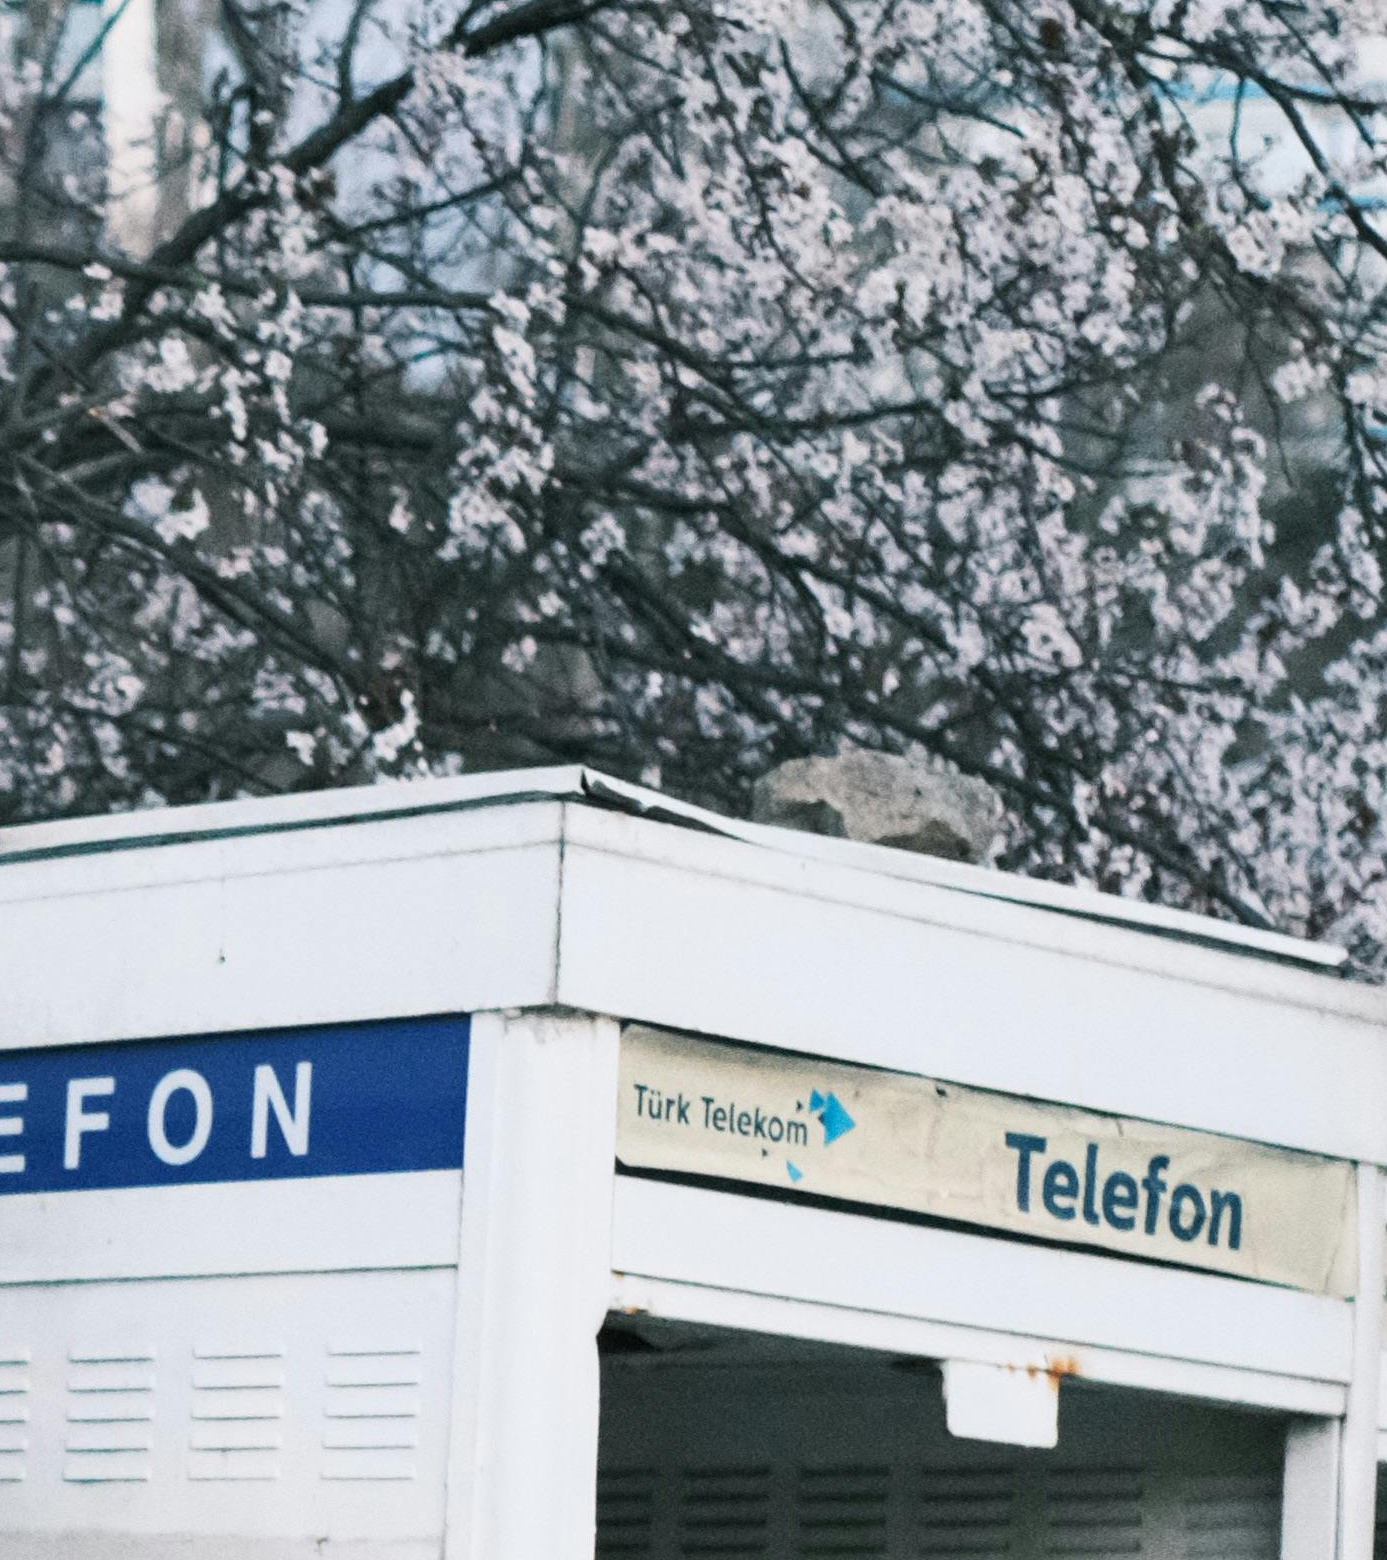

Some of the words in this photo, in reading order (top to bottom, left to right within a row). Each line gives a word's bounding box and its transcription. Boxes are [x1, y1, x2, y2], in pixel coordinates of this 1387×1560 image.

[634, 1083, 690, 1126] Türk
[701, 1096, 808, 1147] Telekom
[1004, 1131, 1243, 1251] Telefon
